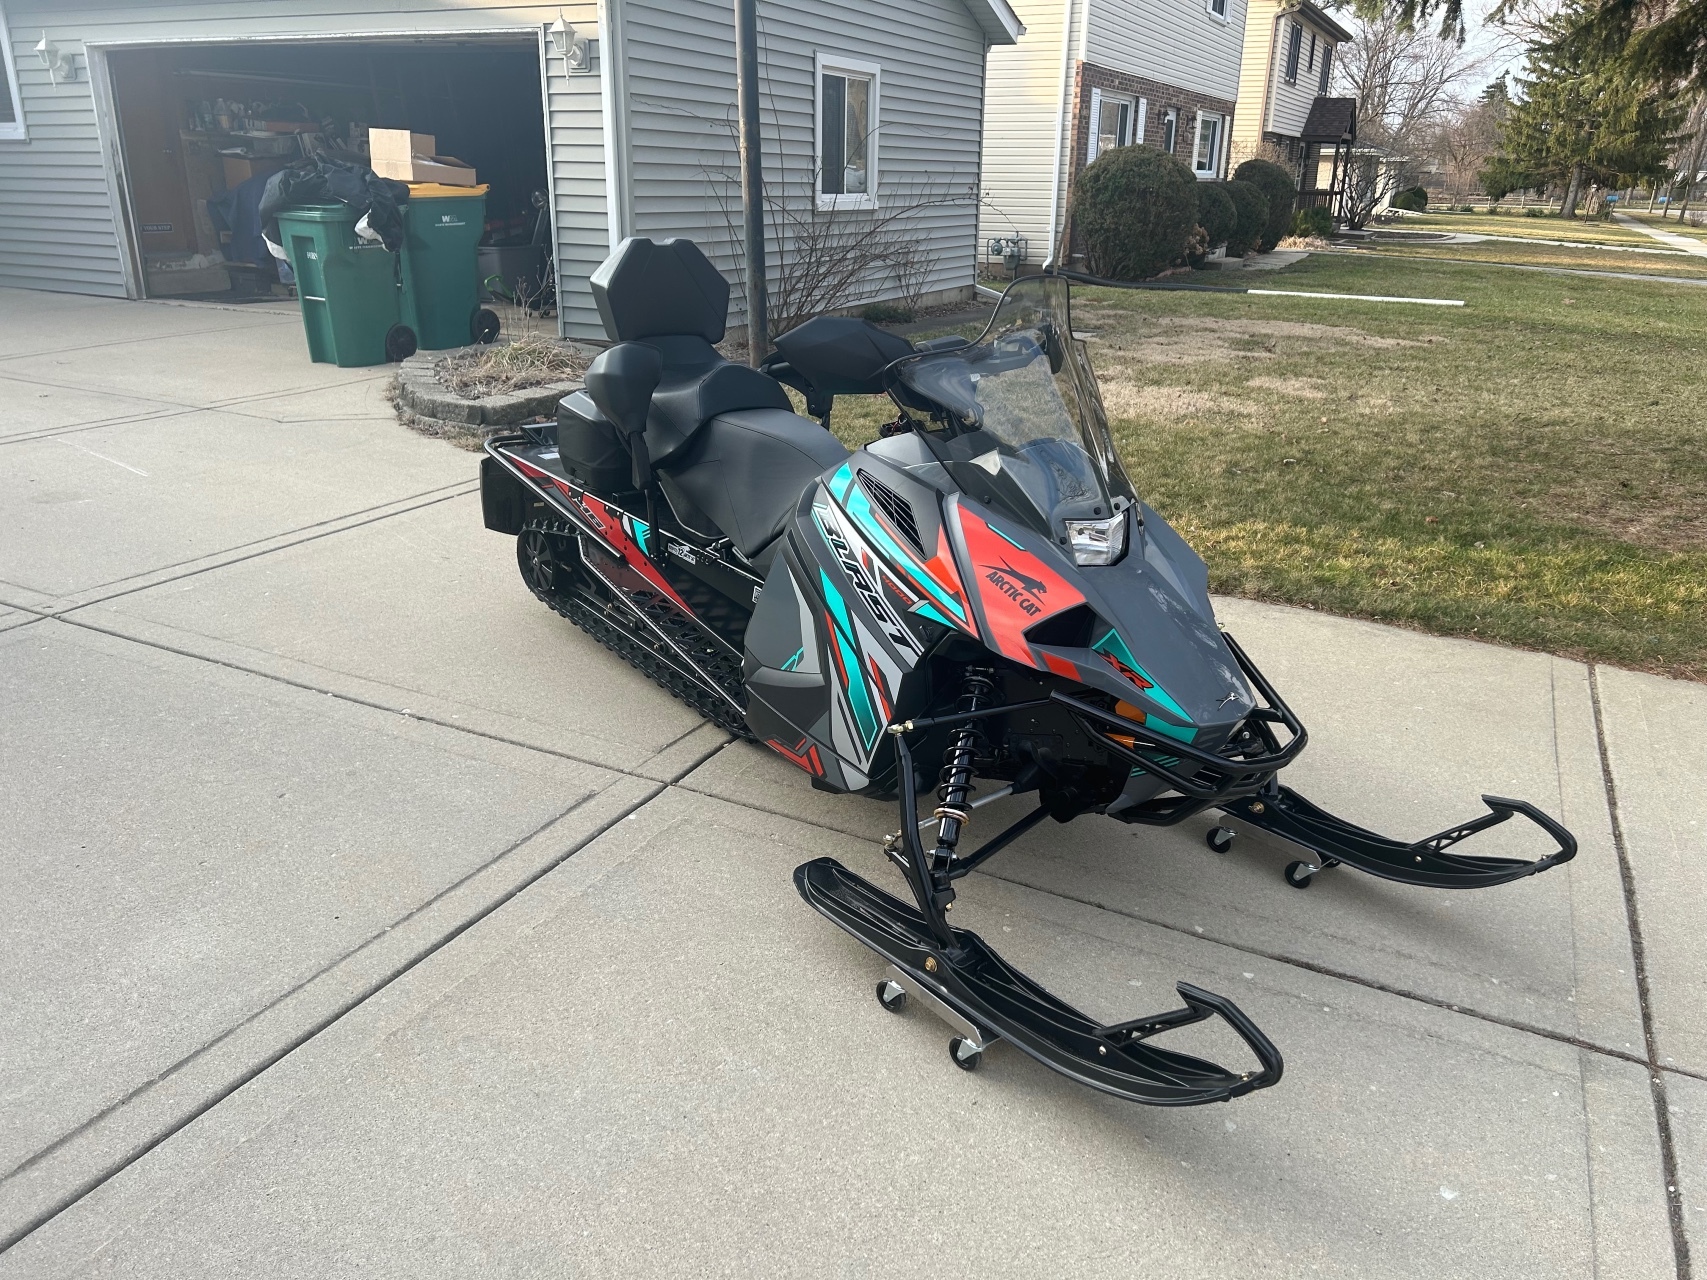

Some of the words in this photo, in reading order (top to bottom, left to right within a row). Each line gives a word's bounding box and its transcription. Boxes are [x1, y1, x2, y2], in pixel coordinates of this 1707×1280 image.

[813, 505, 921, 658] BLAST
[882, 575, 913, 605] 4000
[985, 570, 1024, 602] ARCTIC
[1018, 598, 1042, 617] CAT
[1098, 649, 1155, 691] XR
